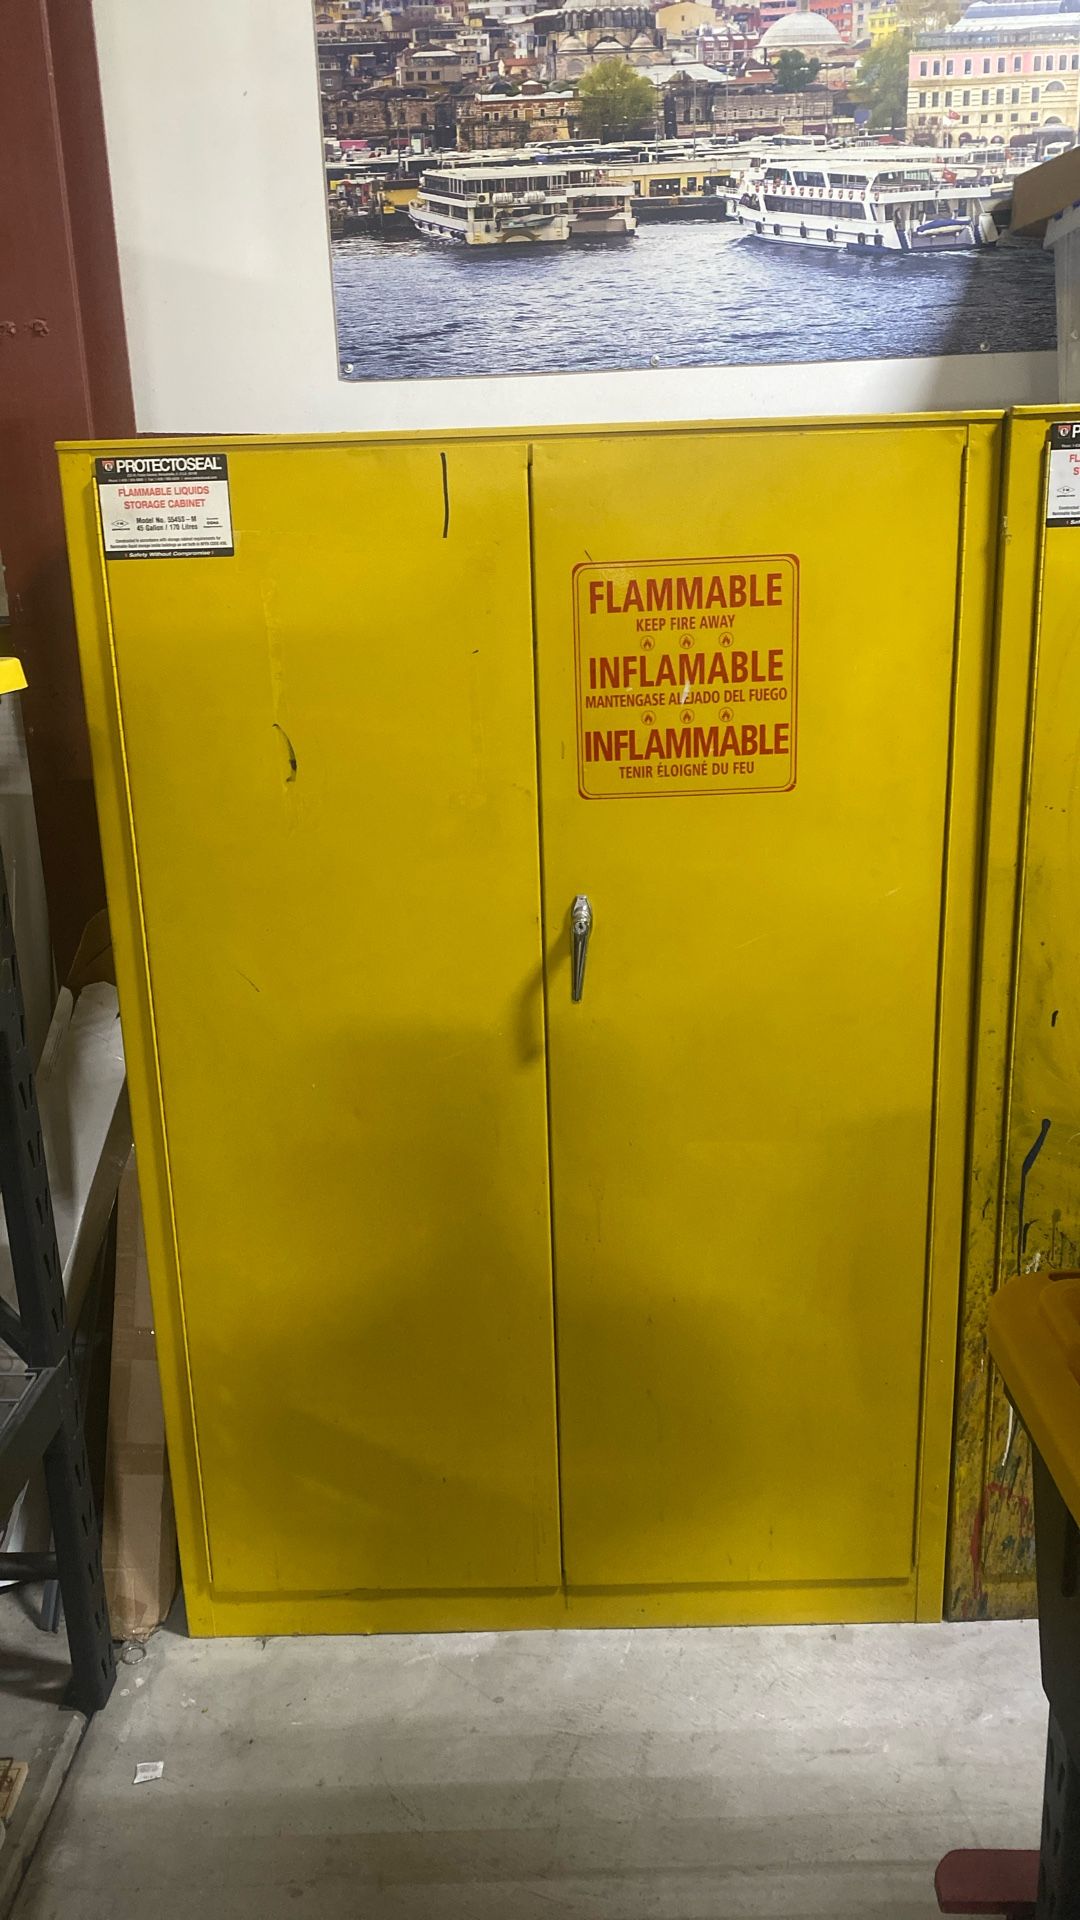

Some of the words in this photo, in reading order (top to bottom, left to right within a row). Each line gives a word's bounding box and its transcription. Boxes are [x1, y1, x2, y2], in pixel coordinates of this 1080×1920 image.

[116, 456, 222, 473] PROTECTOSEAL
[118, 487, 172, 497] FLAMMABLE
[174, 485, 210, 495] LIQUIDS
[124, 500, 166, 510] STORAGE
[168, 498, 206, 509] CABINET
[169, 523, 180, 531] 170
[181, 522, 198, 530] Litres
[589, 573, 783, 615] FLAMMABLE
[636, 617, 666, 632] KEEP
[670, 616, 696, 631] FIRE
[699, 614, 736, 629] AWAY
[589, 649, 784, 690] INFLAMABLE
[585, 692, 665, 709] MANTENGASE
[724, 689, 745, 703] DEL
[749, 687, 788, 702] FUEGO
[584, 723, 789, 762] INFLAMMABLE
[619, 764, 653, 779] TENIR
[657, 760, 708, 778] ÉLOIGNÉ
[711, 761, 729, 775] DU
[733, 761, 755, 774] FEU
